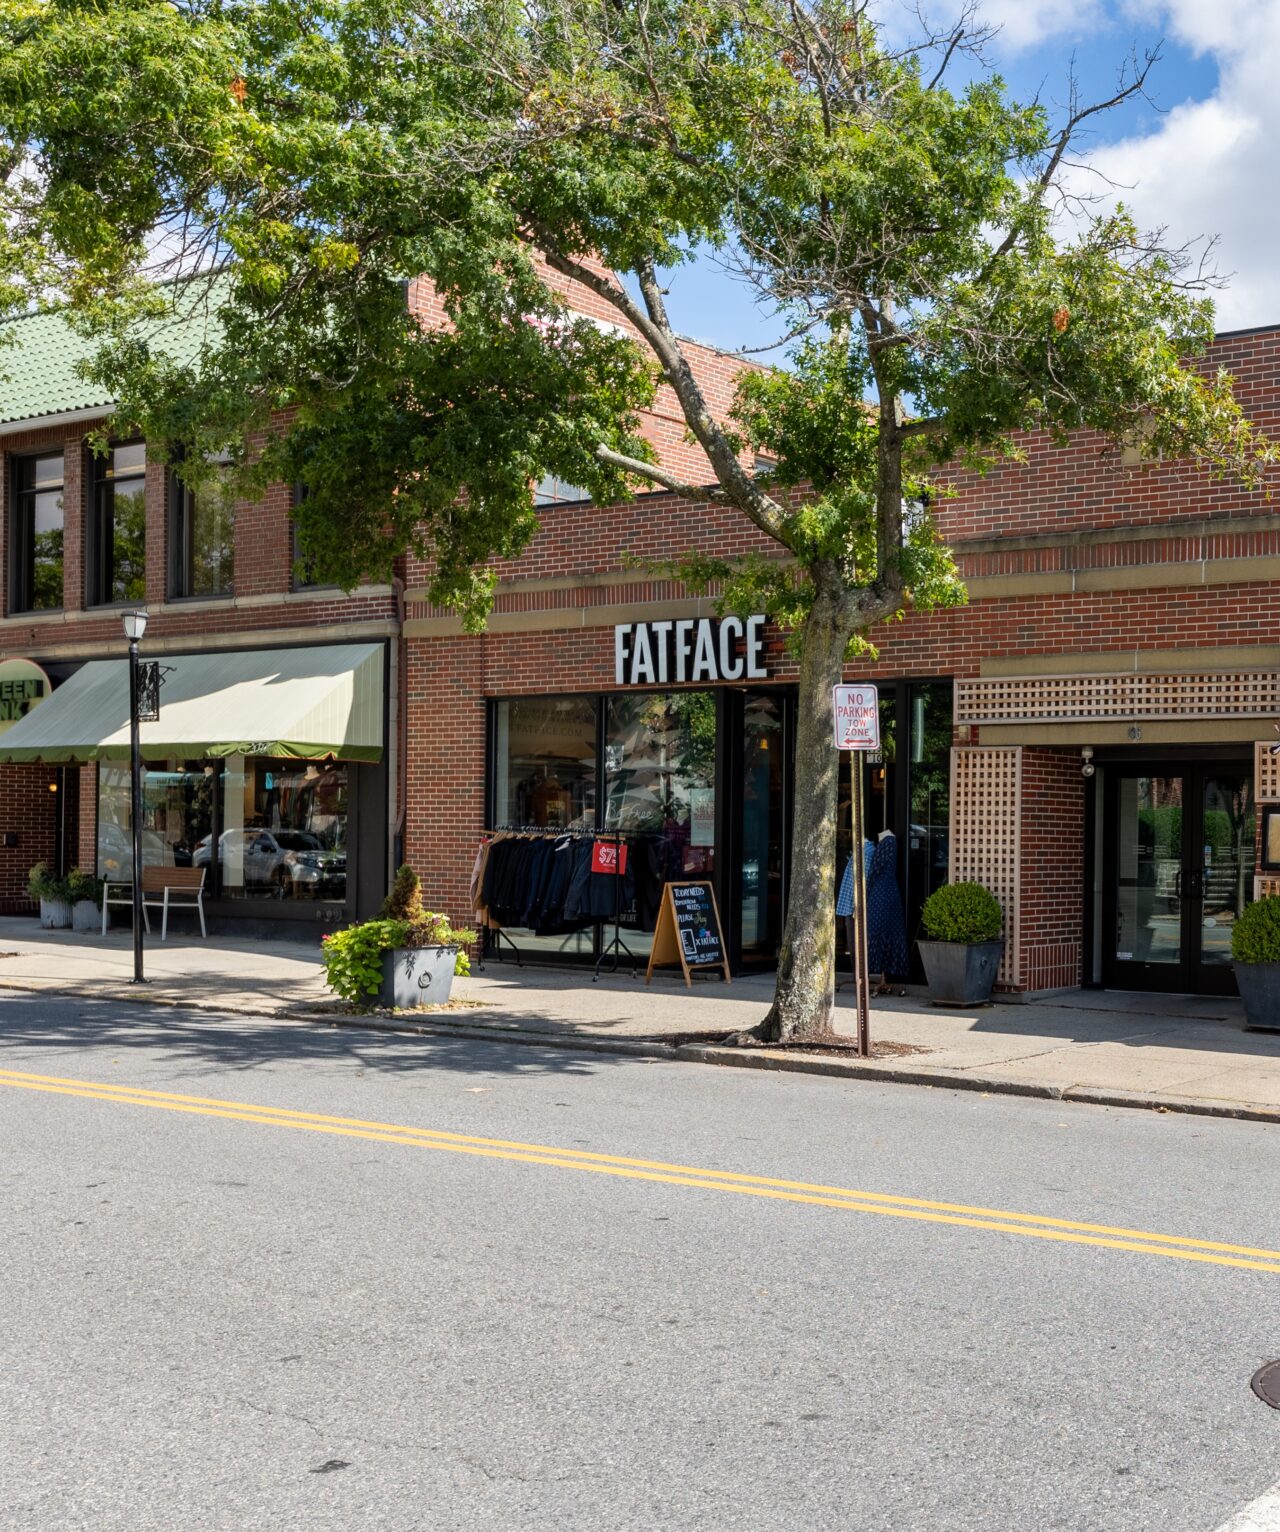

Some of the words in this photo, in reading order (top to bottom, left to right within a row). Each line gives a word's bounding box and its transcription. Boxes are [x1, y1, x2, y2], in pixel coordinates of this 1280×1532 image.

[614, 614, 768, 685] FATFACE
[847, 693, 864, 705] NO
[838, 706, 875, 718] PARKING
[847, 719, 867, 728] TOW
[845, 728, 870, 737] ZONE
